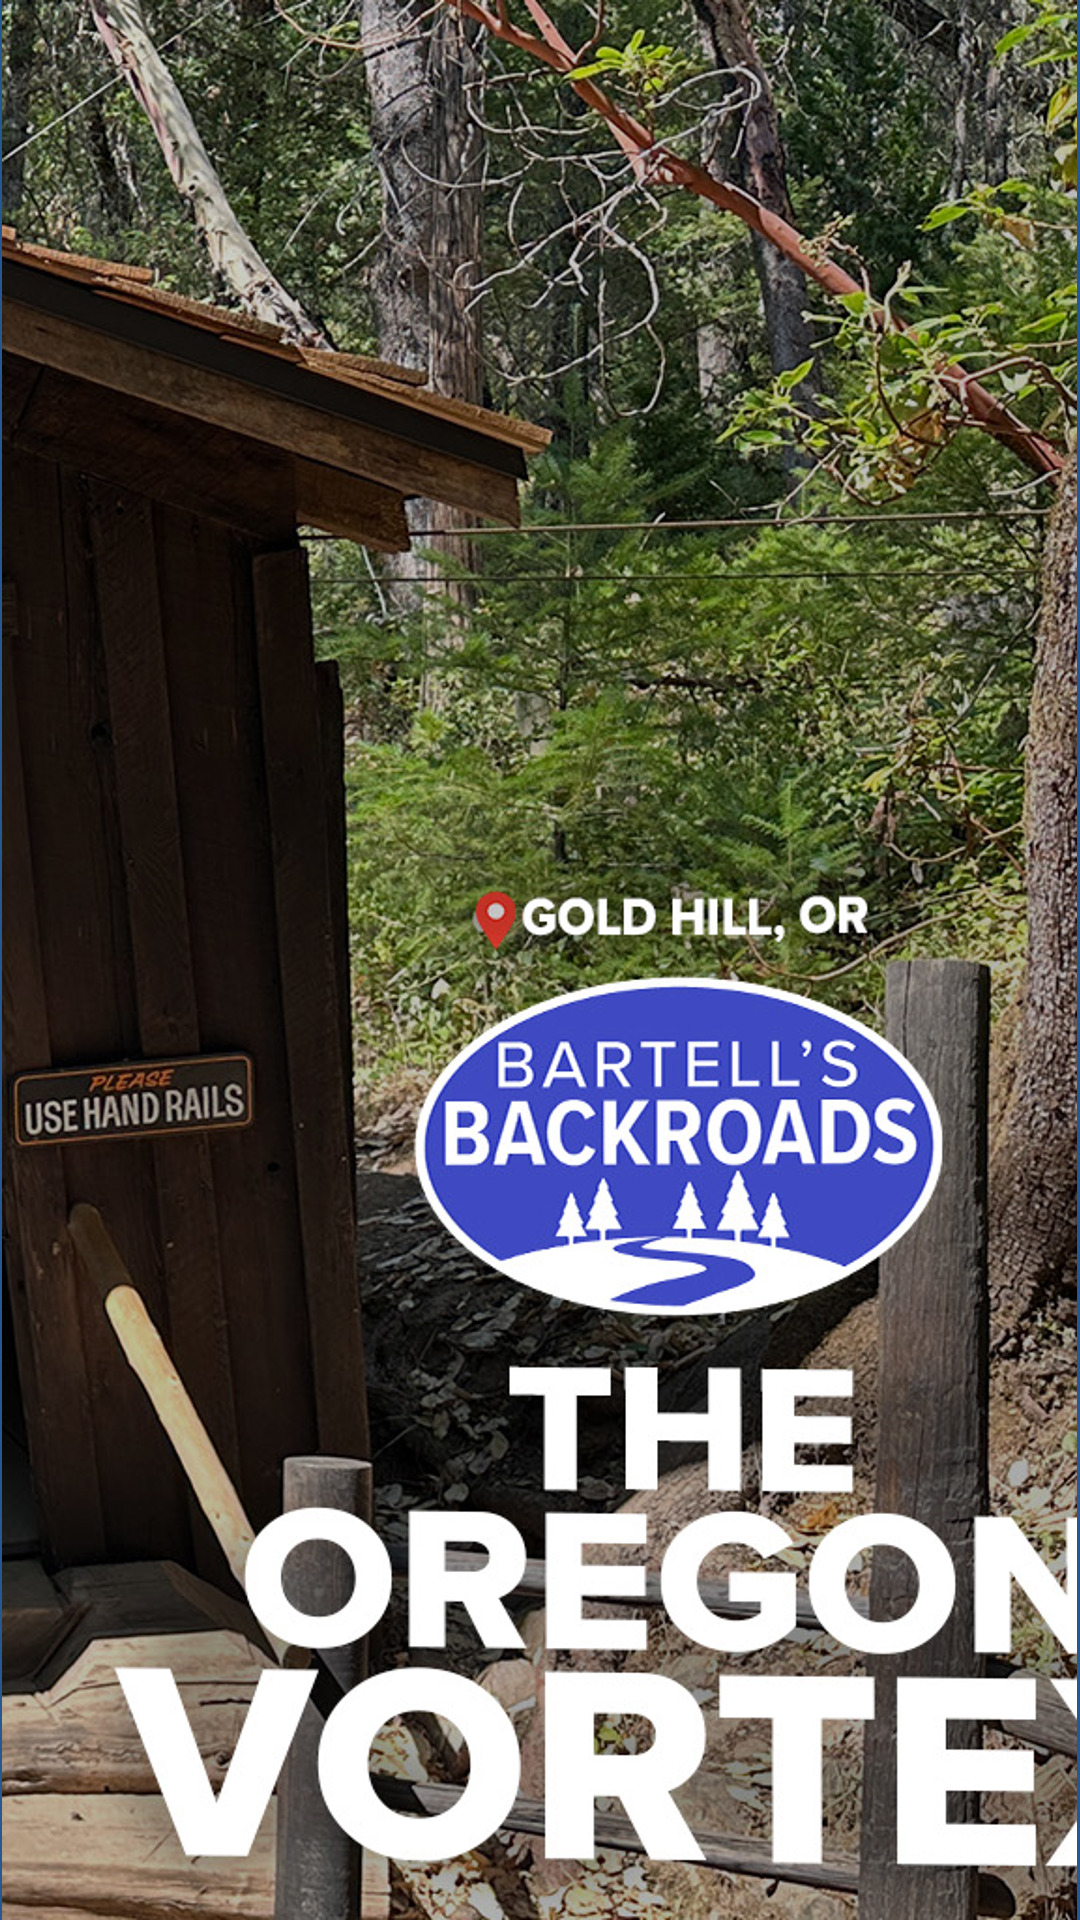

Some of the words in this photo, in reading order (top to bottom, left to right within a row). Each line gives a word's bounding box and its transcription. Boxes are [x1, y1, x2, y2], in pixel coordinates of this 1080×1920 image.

[89, 1069, 175, 1092] PLEASE
[25, 1099, 78, 1136] USE
[83, 1091, 160, 1130] HAND
[165, 1083, 245, 1122] RAILS
